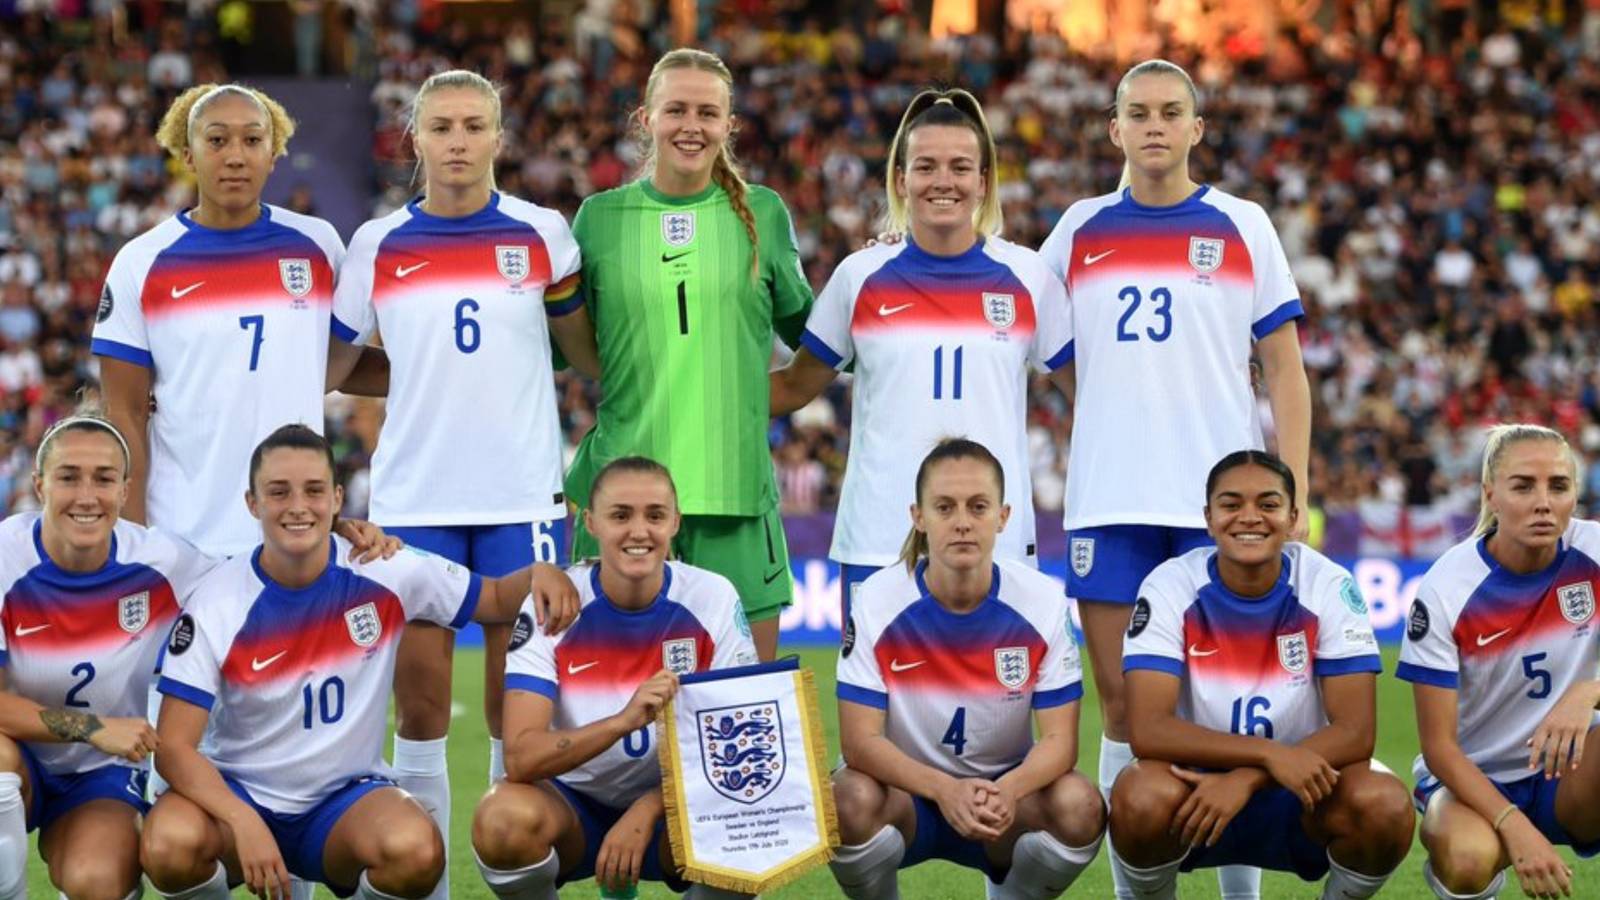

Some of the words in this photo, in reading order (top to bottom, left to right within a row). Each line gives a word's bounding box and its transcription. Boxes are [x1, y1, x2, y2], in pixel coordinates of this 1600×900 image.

[453, 298, 480, 354] 6
[677, 280, 688, 335] 1
[1117, 286, 1173, 342] 23
[239, 314, 264, 371] 7
[933, 345, 963, 400] 11
[532, 520, 556, 564] 6
[65, 662, 95, 707] 2
[303, 675, 345, 729] 10
[1522, 652, 1552, 699] 5
[942, 707, 967, 756] 4
[1231, 696, 1274, 740] 16
